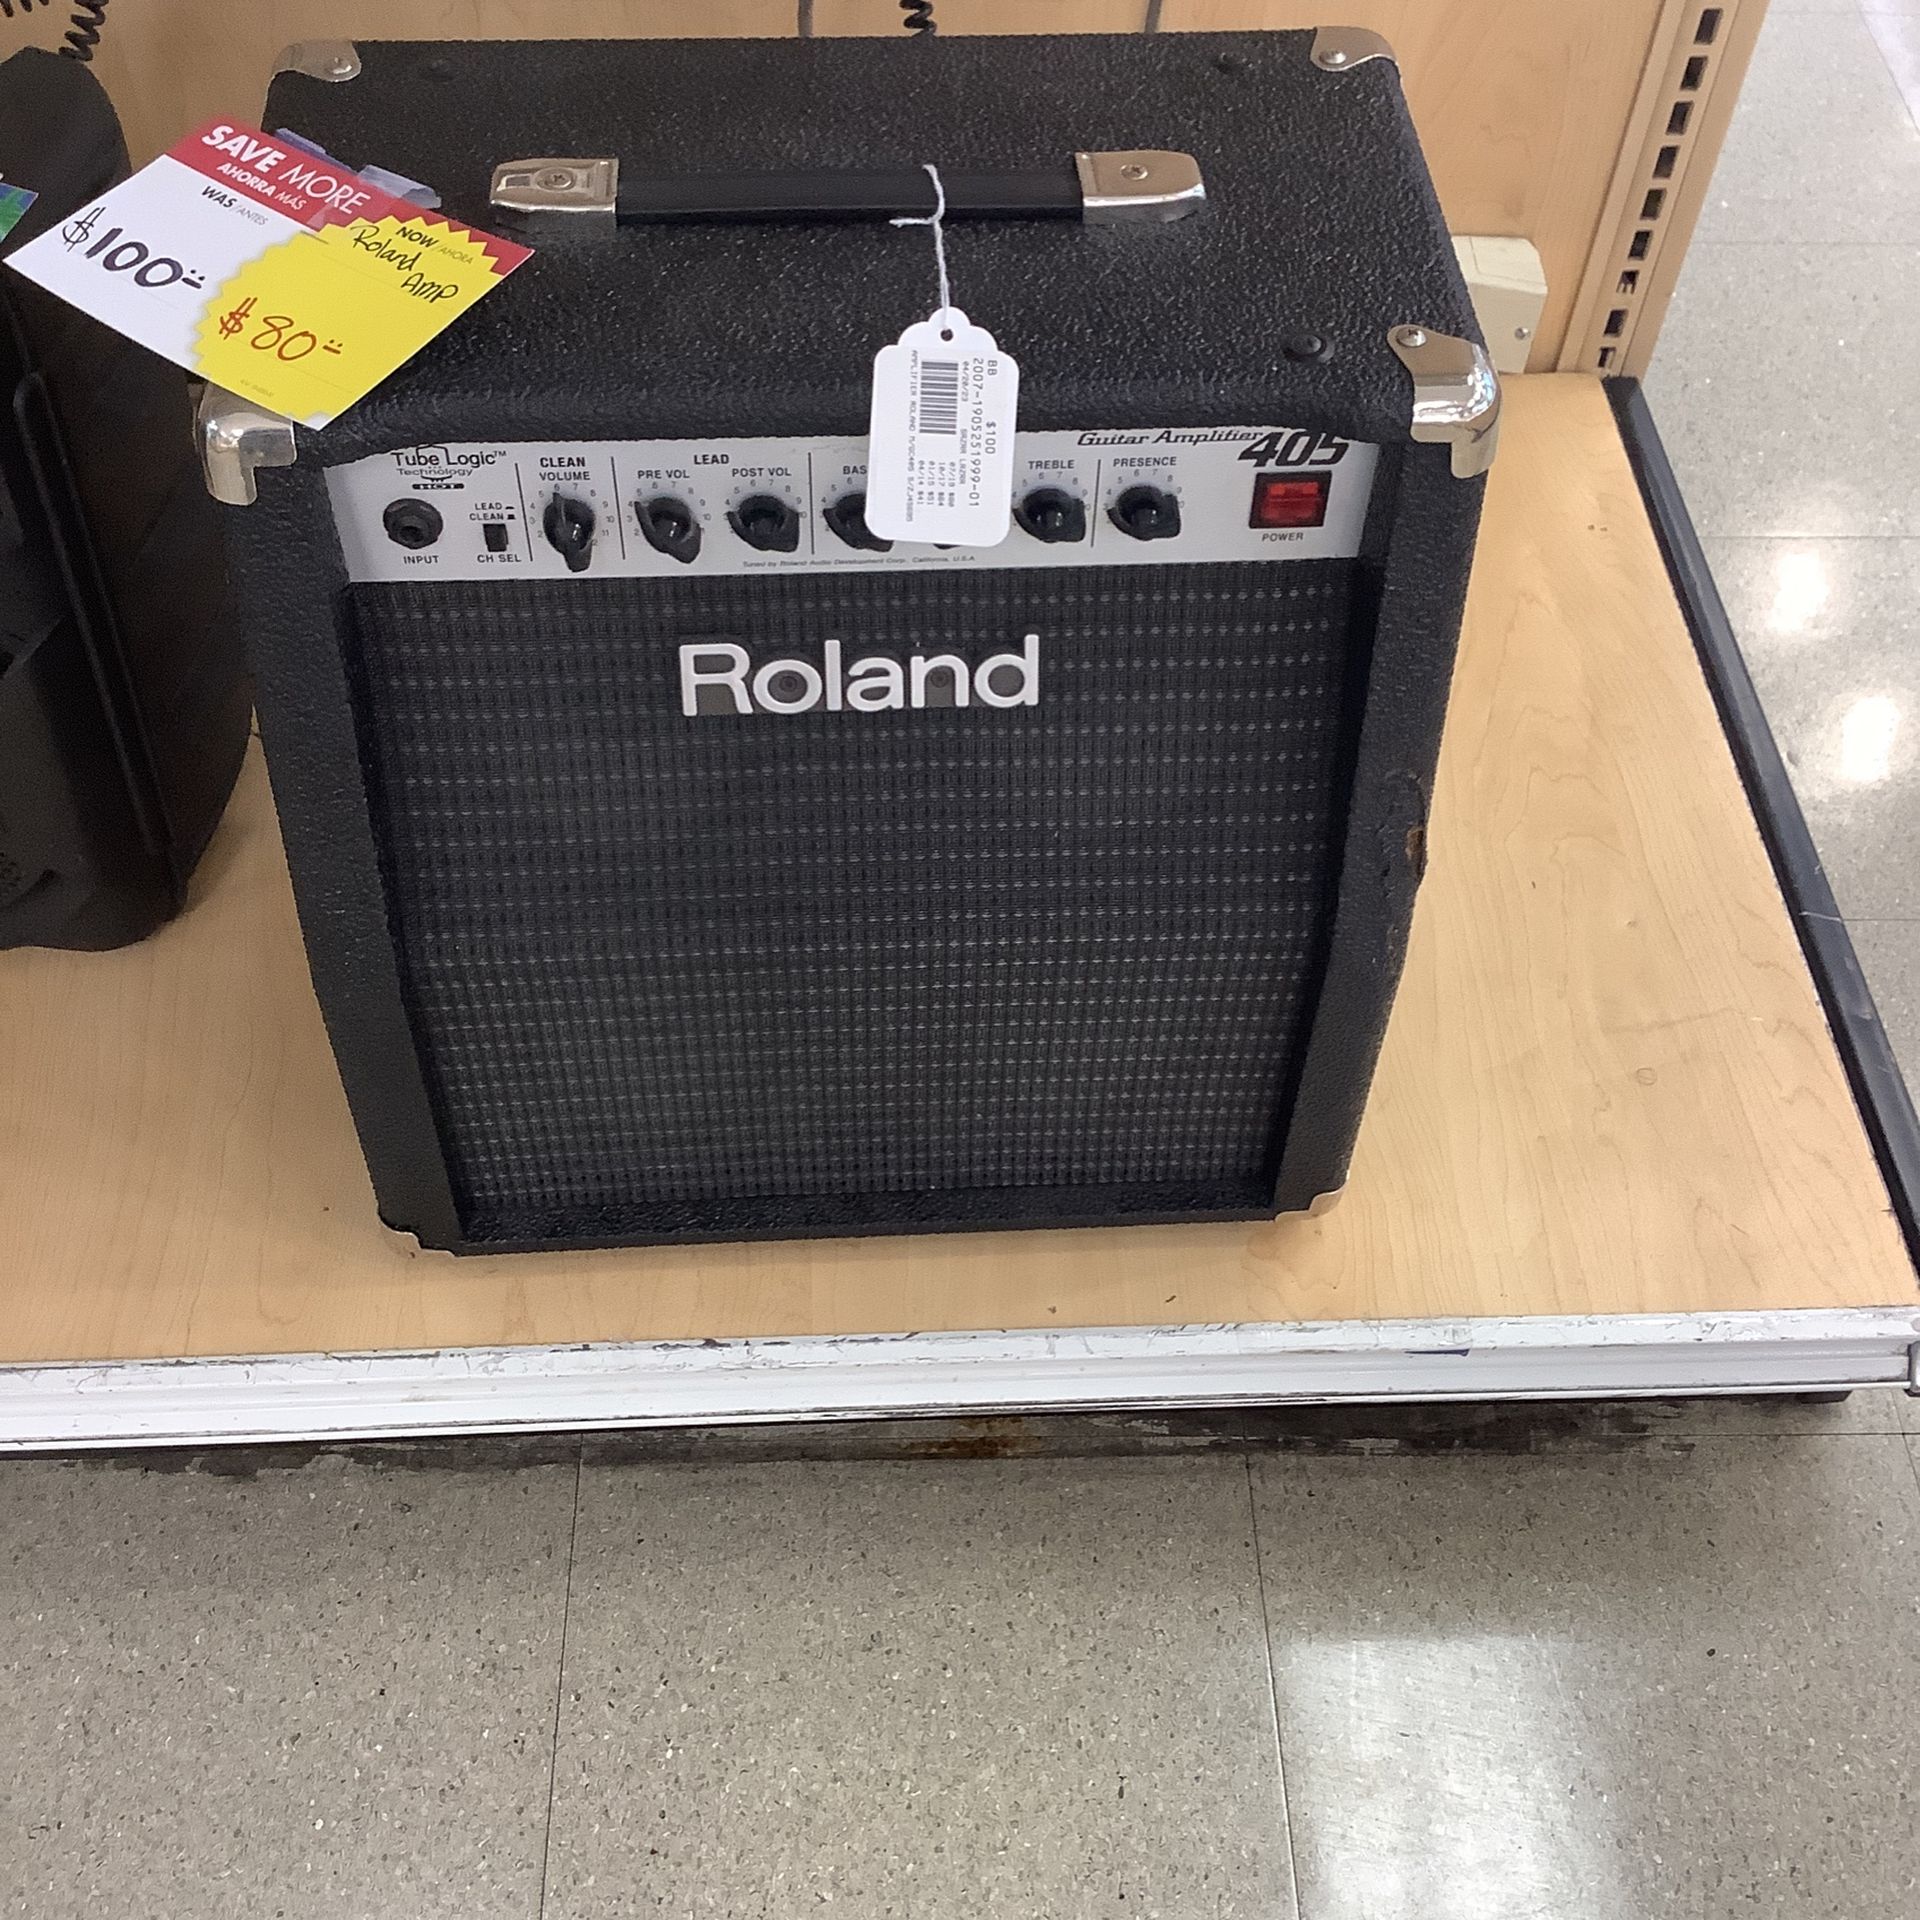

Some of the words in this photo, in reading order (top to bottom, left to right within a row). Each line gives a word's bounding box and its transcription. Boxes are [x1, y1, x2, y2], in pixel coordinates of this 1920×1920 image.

[201, 124, 287, 173] SAVE
[278, 163, 371, 214] MORE
[216, 162, 277, 198] AHORRA
[275, 191, 308, 210] MÁS
[350, 224, 422, 272] Roland
[910, 350, 918, 397] AMPLIFIER
[987, 359, 998, 376] BB
[908, 400, 917, 431] ROLAND
[969, 357, 984, 506] 2007-1905251999-01
[1077, 431, 1150, 446] Guitar
[1152, 429, 1263, 446] Amplifier
[985, 421, 997, 455] $100
[1237, 431, 1350, 468] 405
[390, 450, 440, 467] Tube
[540, 456, 586, 468] CLEAN
[694, 453, 730, 465] LEAD
[1028, 459, 1075, 470] TREBLE
[1113, 456, 1177, 467] PRESENCE
[396, 468, 473, 477] Technology
[539, 471, 591, 481] VOLUME
[637, 469, 662, 479] PRE
[665, 469, 690, 479] VOL
[732, 467, 764, 477] POST
[768, 467, 792, 477] VOL
[474, 502, 502, 510] LEAD
[469, 513, 504, 521] CLEAN
[1261, 532, 1304, 542] POWER
[403, 555, 439, 564] INPUT
[477, 554, 494, 563] CH
[498, 554, 522, 563] SEL
[679, 634, 1040, 717] Roland
